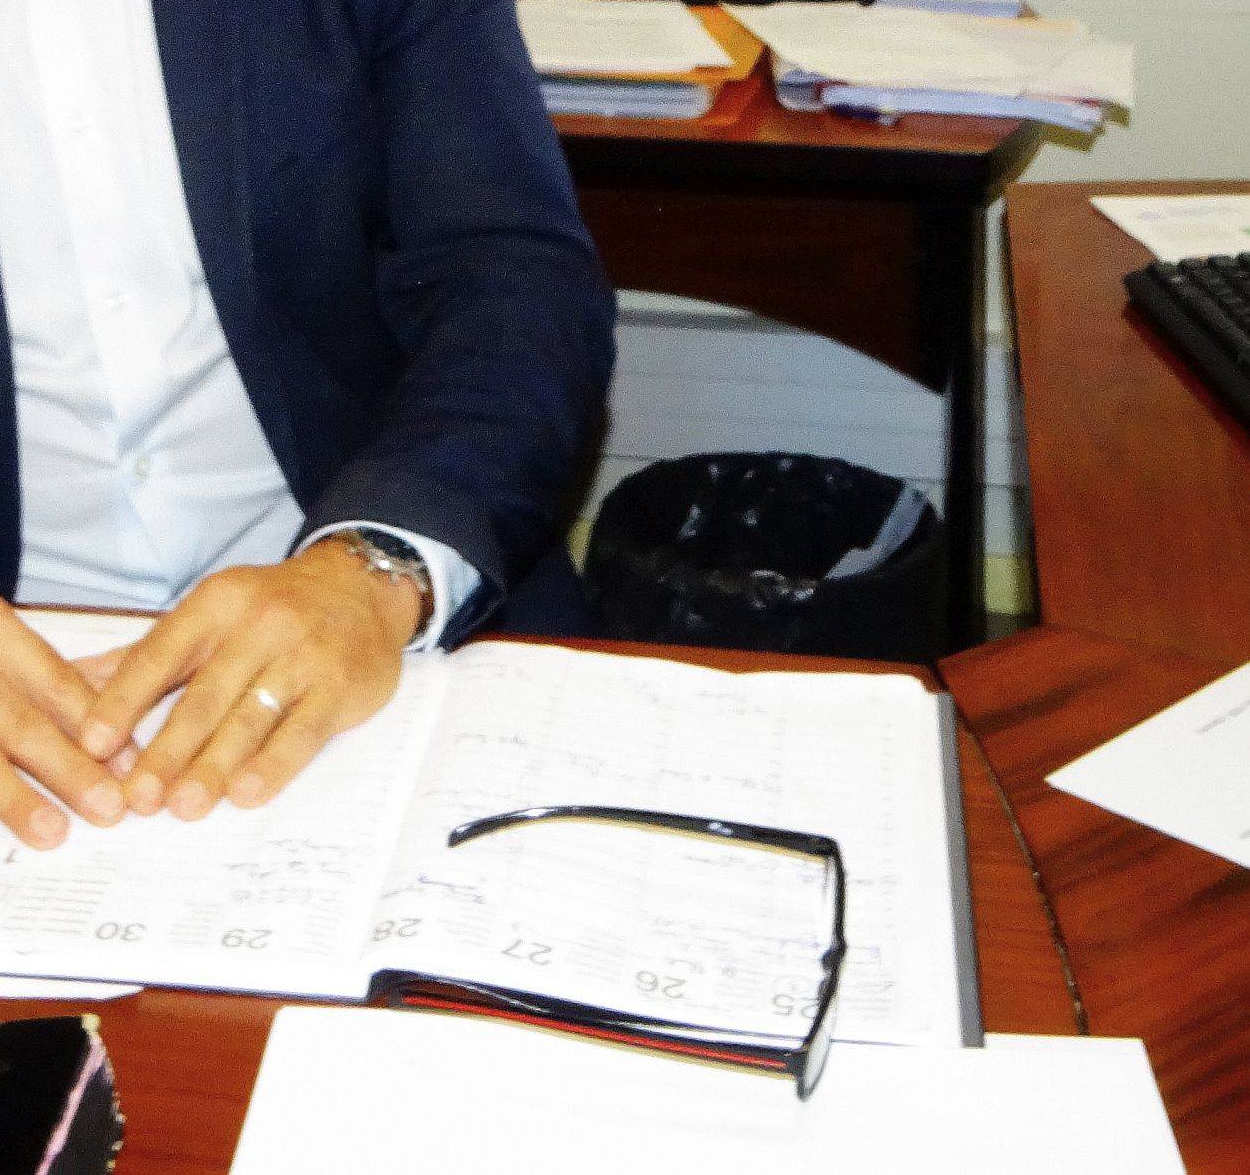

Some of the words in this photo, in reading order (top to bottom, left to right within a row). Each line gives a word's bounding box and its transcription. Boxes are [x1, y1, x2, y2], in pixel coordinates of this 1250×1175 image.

[95, 922, 147, 942] 30
[220, 928, 275, 950] 29
[372, 918, 422, 942] 28
[502, 939, 553, 966] 27
[636, 971, 687, 1000] 26
[770, 994, 818, 1020] 25
